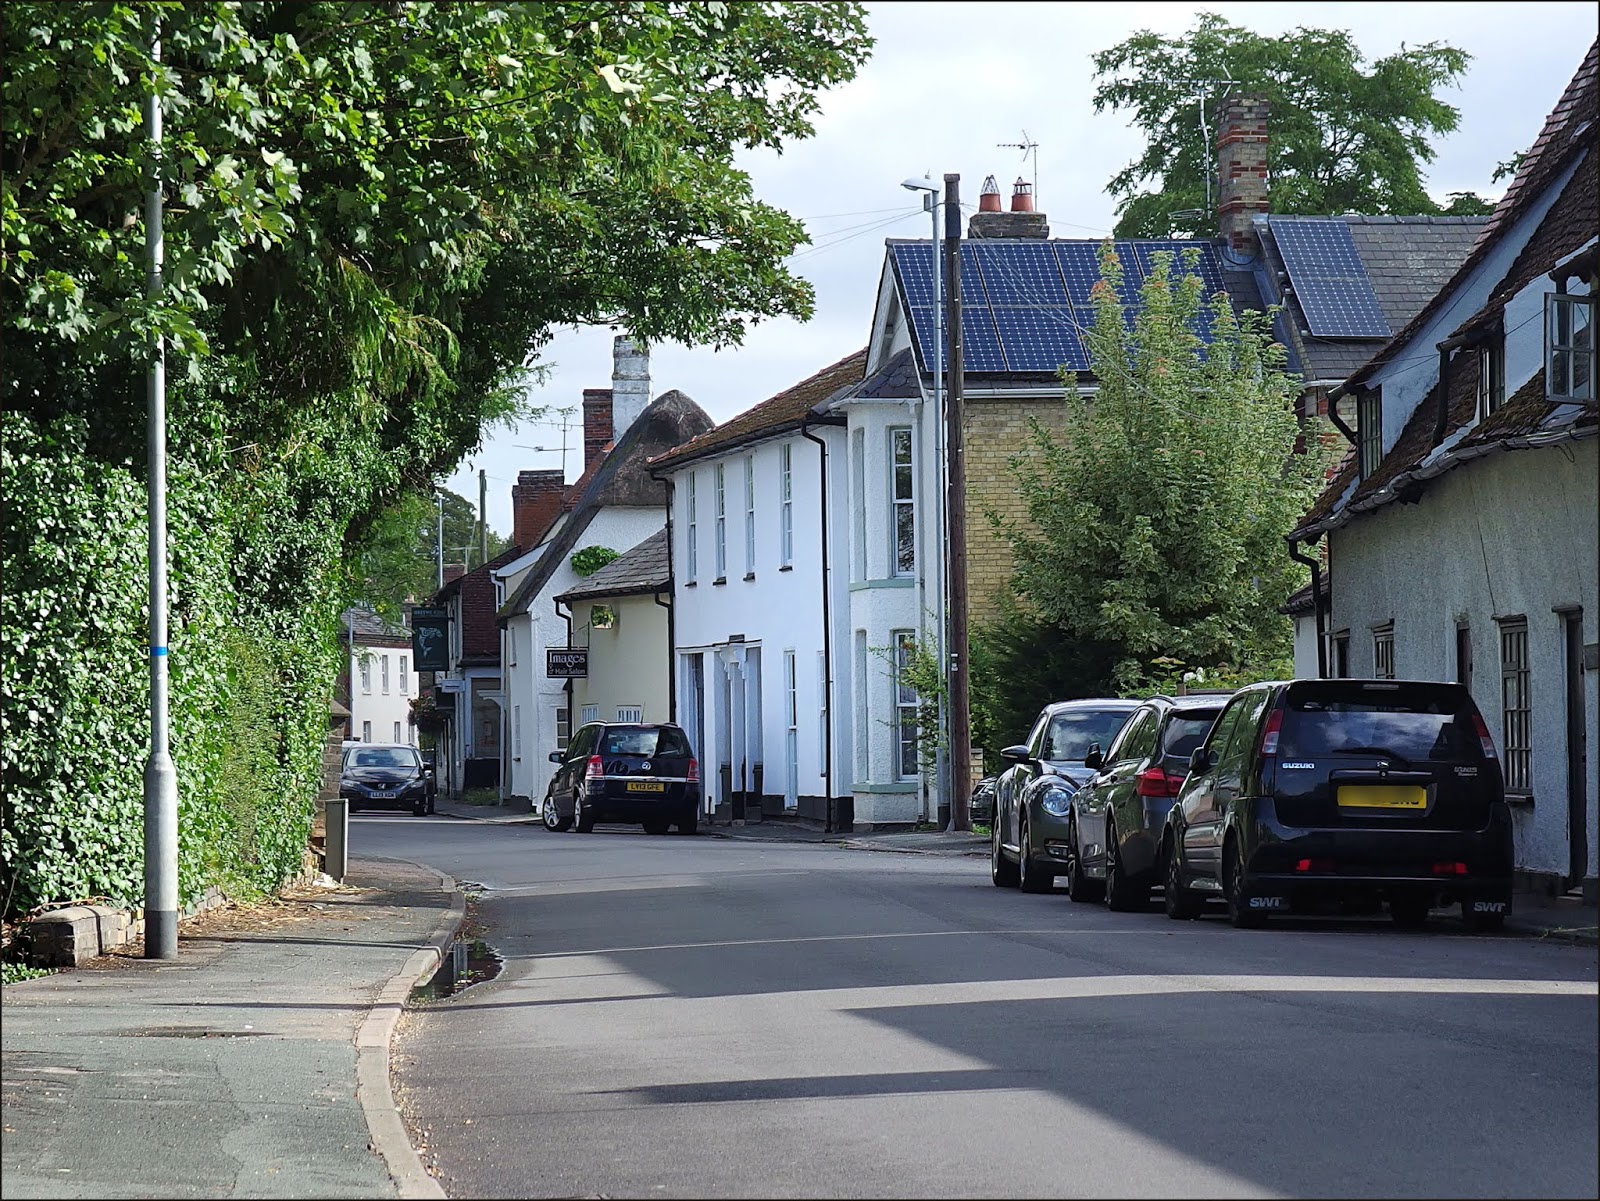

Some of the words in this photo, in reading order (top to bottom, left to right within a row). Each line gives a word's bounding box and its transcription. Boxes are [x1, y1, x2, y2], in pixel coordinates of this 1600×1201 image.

[549, 651, 586, 668] Images
[1250, 896, 1282, 907] SWT
[1474, 901, 1506, 912] SWT
